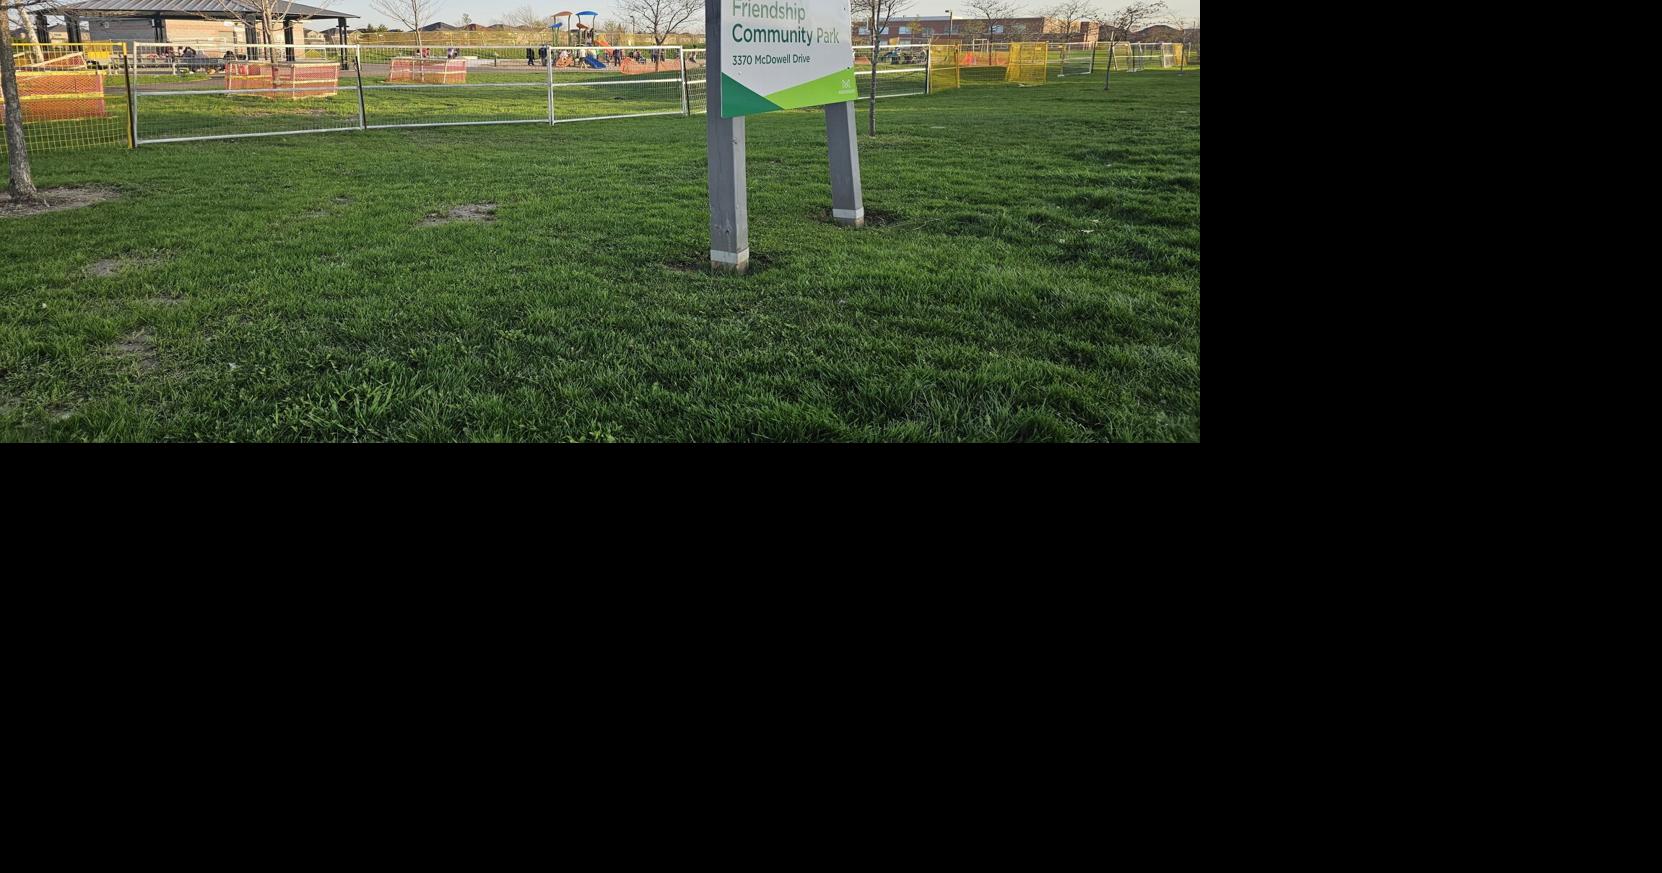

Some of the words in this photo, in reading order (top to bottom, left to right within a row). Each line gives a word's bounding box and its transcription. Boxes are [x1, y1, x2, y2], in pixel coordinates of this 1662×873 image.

[732, 0, 806, 24] Friendship
[732, 23, 814, 46] Community
[816, 27, 840, 44] Park
[732, 55, 753, 66] 3370
[754, 54, 791, 65] McDowell
[792, 53, 811, 63] Drive
